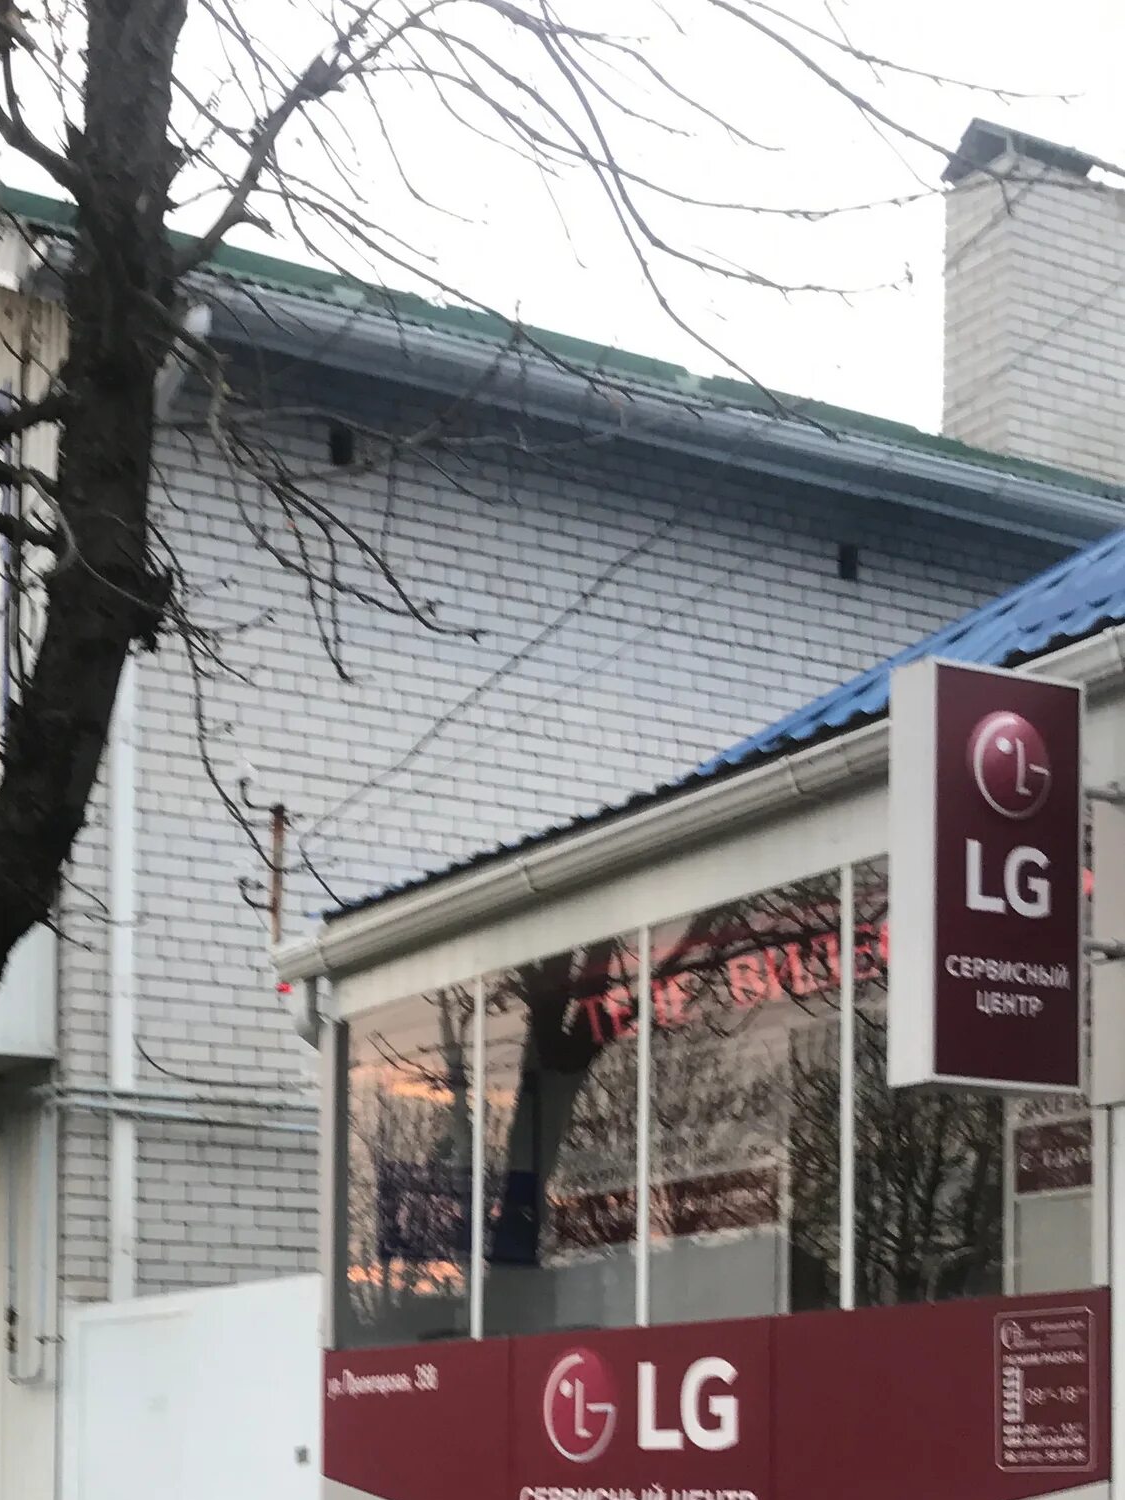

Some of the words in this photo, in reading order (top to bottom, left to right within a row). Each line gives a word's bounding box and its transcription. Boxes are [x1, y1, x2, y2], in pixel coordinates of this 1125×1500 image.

[966, 838, 1051, 918] LG
[945, 954, 1071, 991] СЕРВИСНЫЙ
[976, 990, 1044, 1018] ЦЕНТР
[637, 1356, 740, 1451] LG
